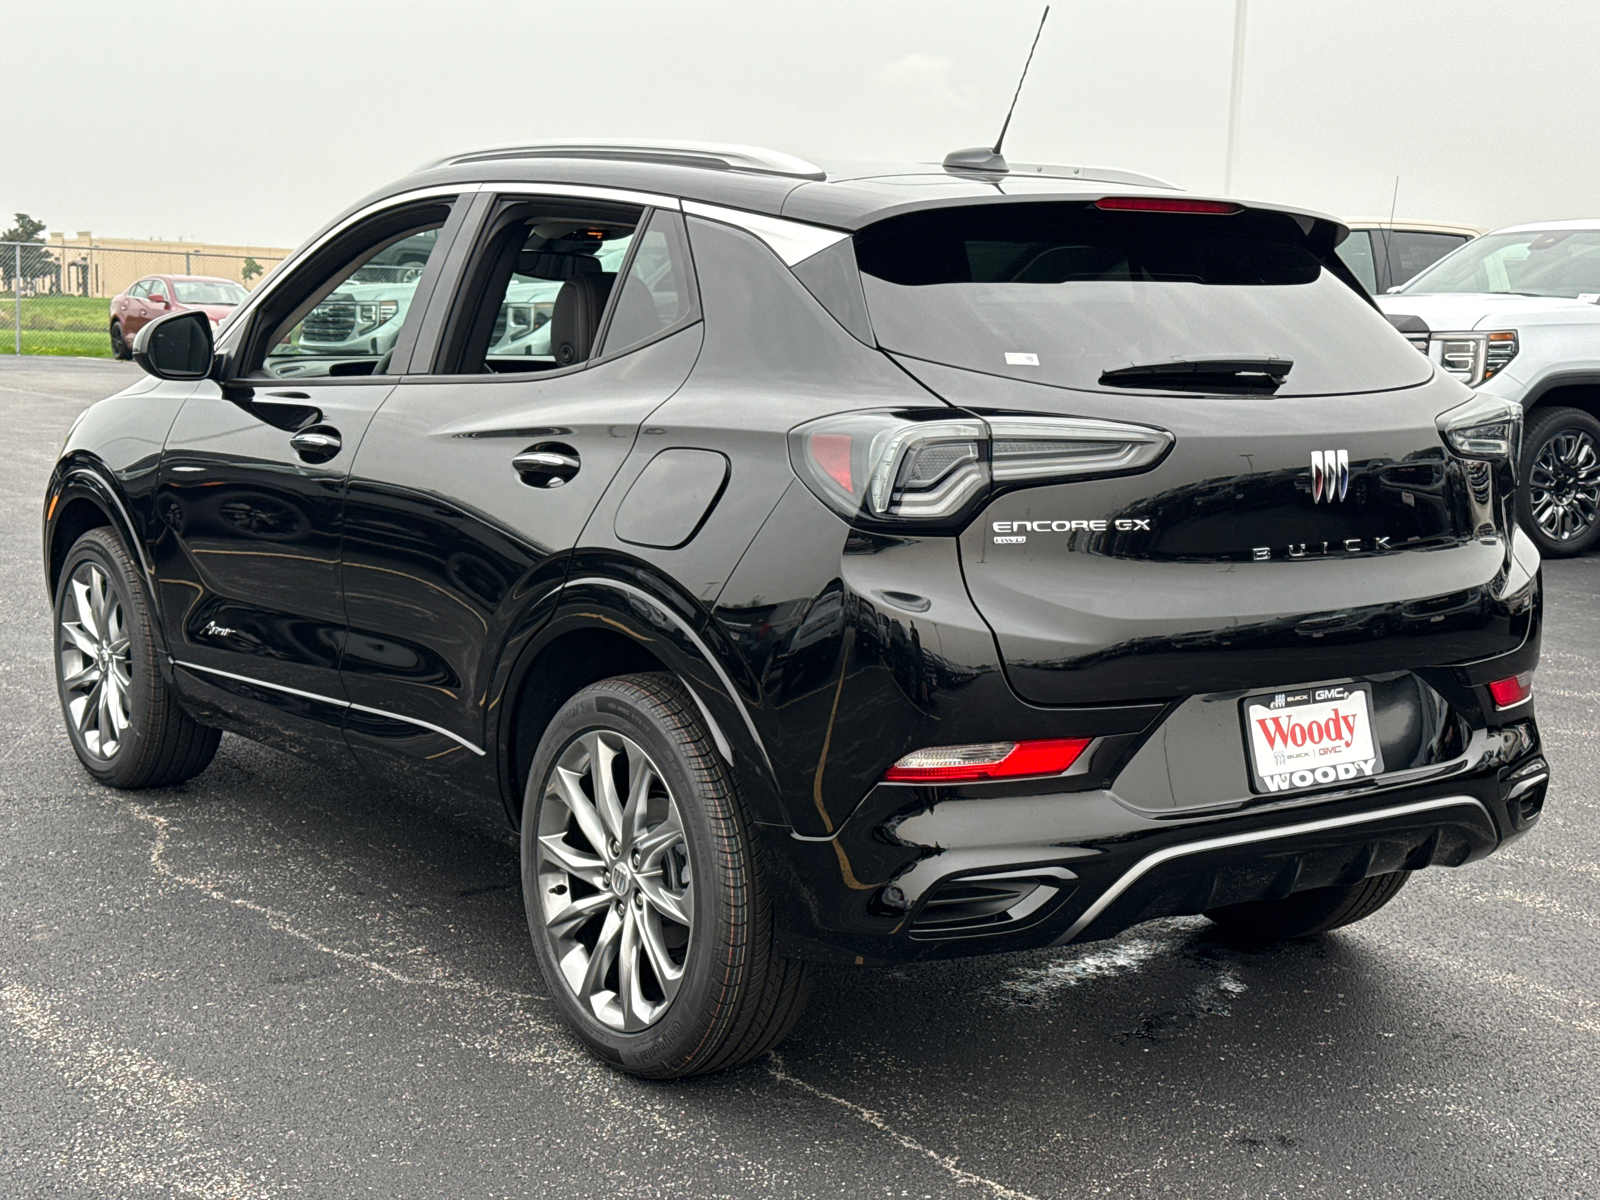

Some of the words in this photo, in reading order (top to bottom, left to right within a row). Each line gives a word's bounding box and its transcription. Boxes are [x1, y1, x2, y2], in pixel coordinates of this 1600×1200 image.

[992, 519, 1107, 533] ENCORE
[1114, 518, 1151, 531] GX
[994, 536, 1026, 544] AWD
[1252, 536, 1391, 561] BUICK
[1286, 694, 1309, 702] BUICK
[1315, 687, 1344, 700] GMC
[1256, 708, 1357, 751] Woody
[1286, 751, 1310, 760] BUICK
[1318, 745, 1342, 756] GMC
[1263, 758, 1377, 792] WOODY
